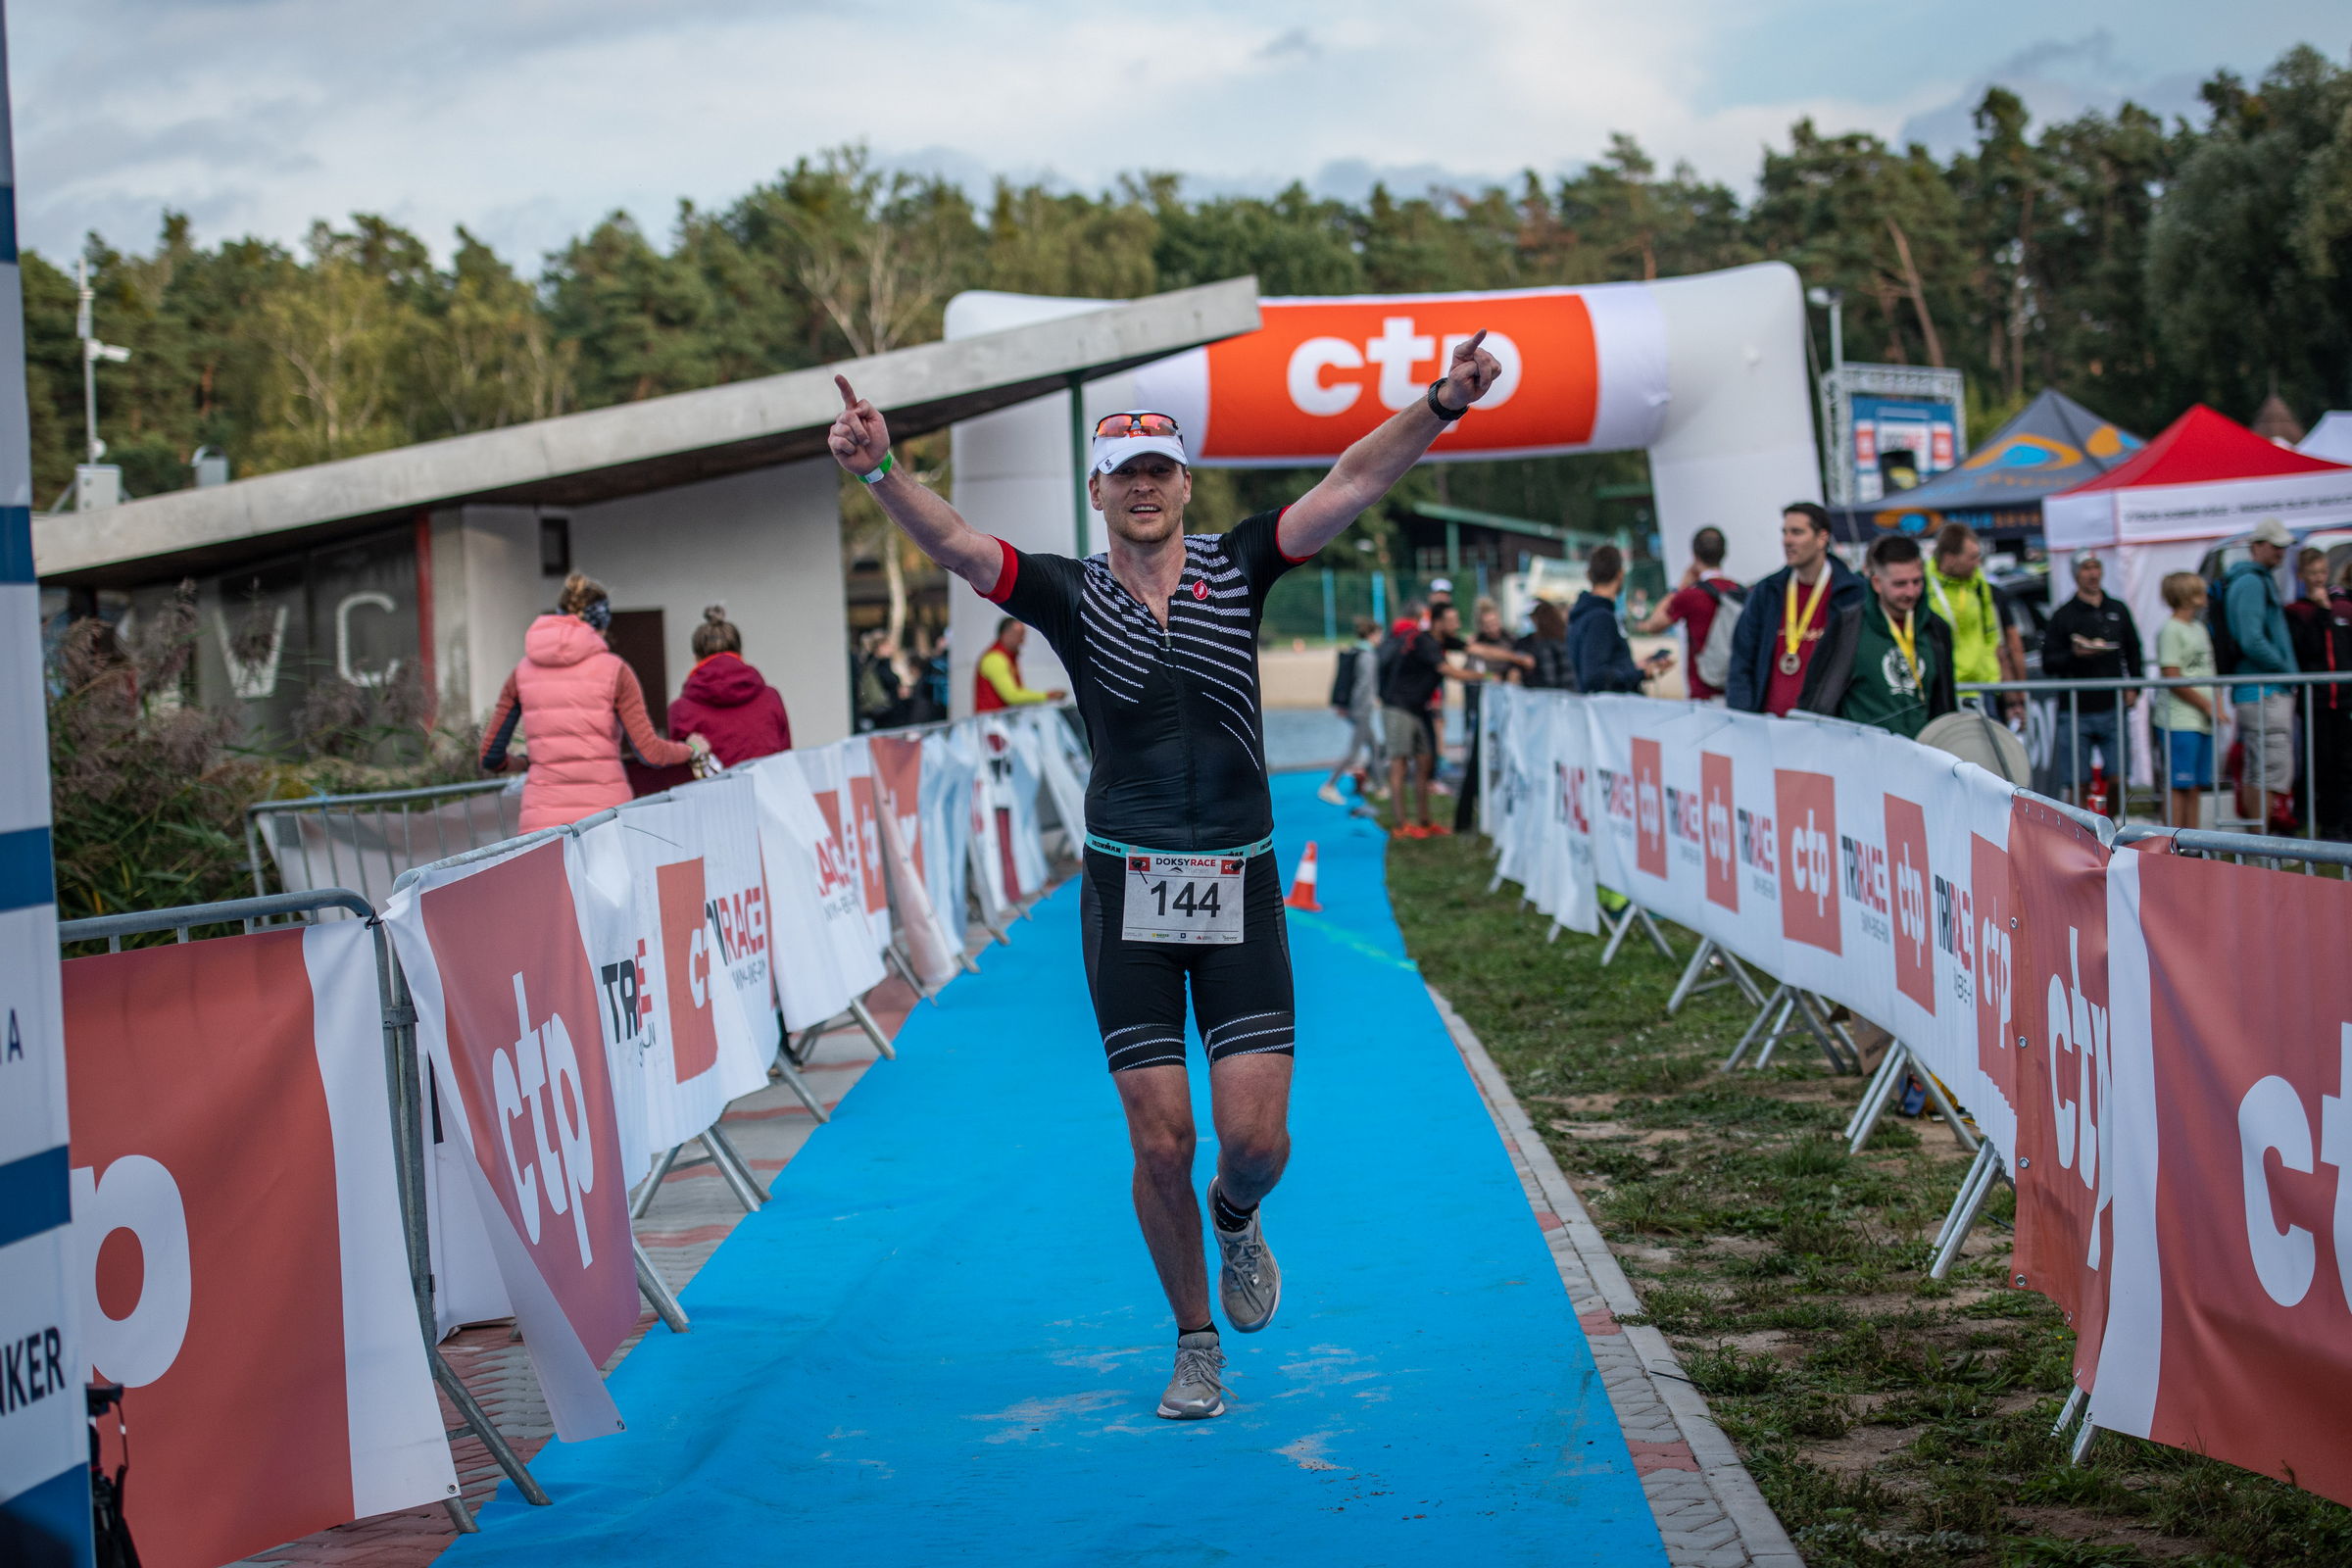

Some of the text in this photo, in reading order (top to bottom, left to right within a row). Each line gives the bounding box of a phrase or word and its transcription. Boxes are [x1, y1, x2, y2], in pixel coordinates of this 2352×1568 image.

[1287, 317, 1523, 433] ctp
[1707, 786, 1731, 881] ctp
[1791, 808, 1830, 917] ctp
[1841, 835, 1887, 915] TRIRACE
[1151, 880, 1221, 917] 144
[1897, 841, 1926, 968] ctp
[1982, 895, 2012, 1051] ctp
[493, 971, 594, 1269] ctp
